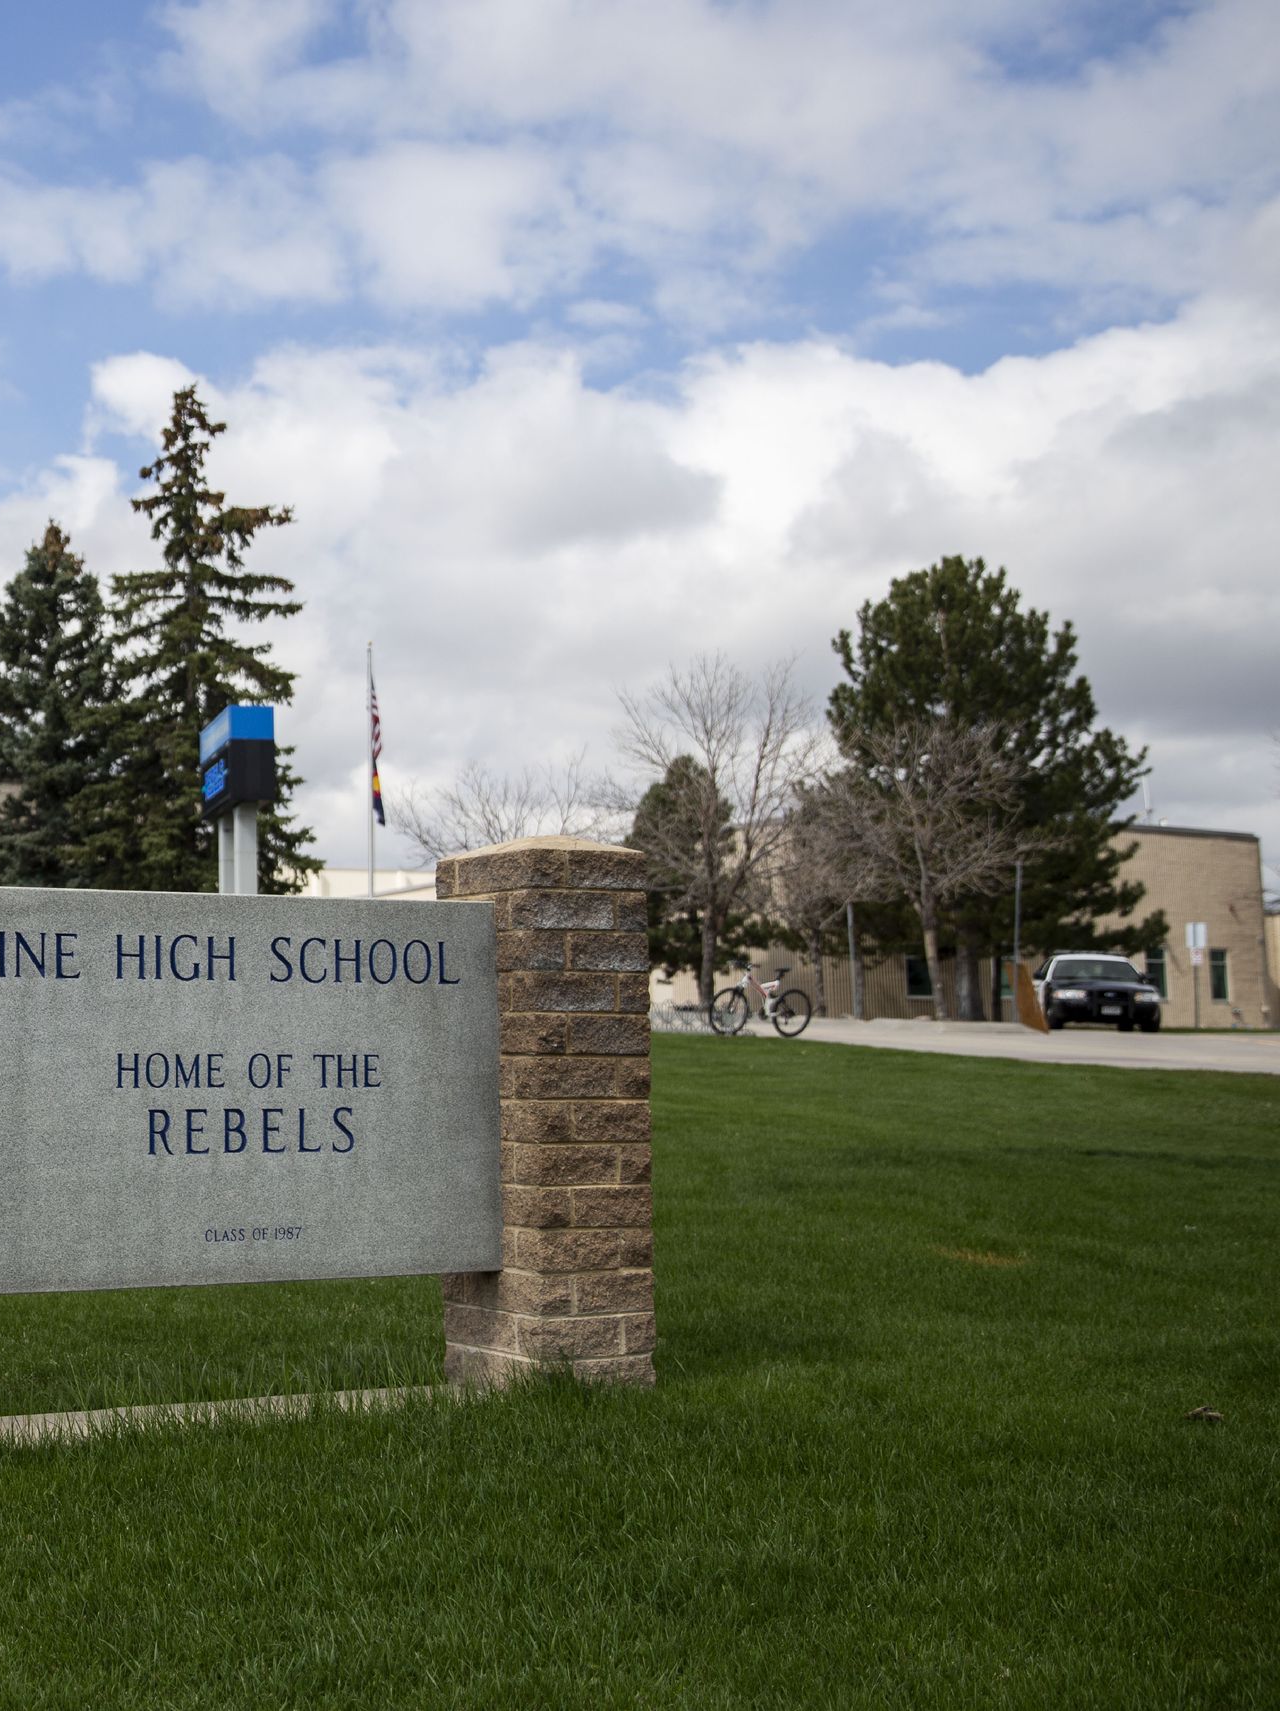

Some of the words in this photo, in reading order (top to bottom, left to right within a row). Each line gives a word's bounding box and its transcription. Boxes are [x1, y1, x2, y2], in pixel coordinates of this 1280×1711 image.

[115, 934, 237, 981] HIGH
[269, 937, 461, 984] SCHOOL
[115, 1053, 225, 1089] HOME
[248, 1053, 293, 1089] OF
[313, 1054, 382, 1088] THE
[147, 1107, 356, 1156] REBELS
[205, 1228, 245, 1242] CLASS
[252, 1228, 269, 1240] OF
[274, 1227, 302, 1241] 1987
